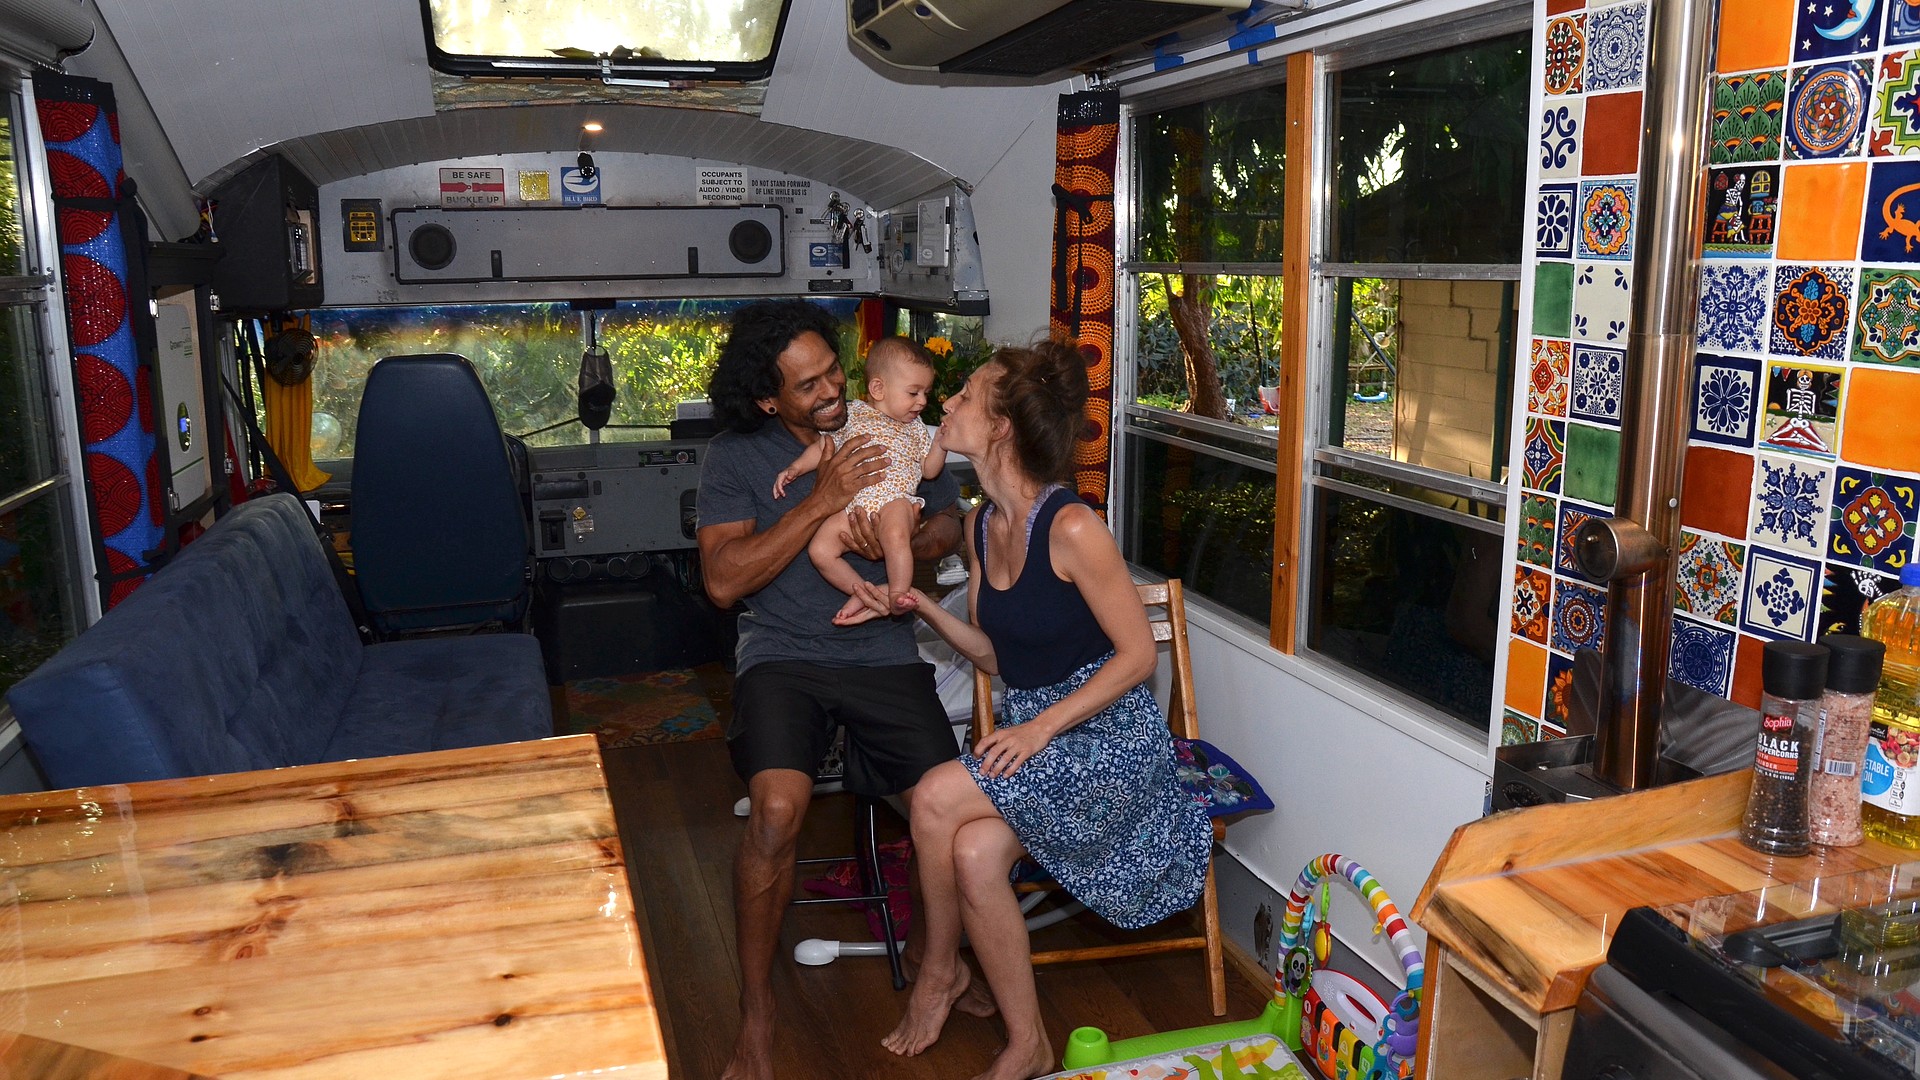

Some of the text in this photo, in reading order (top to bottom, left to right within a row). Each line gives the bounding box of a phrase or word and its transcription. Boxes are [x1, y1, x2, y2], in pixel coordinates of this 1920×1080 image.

[452, 171, 491, 179] BE SAFE
[770, 180, 786, 188] STAND
[786, 180, 811, 188] FORWARD
[775, 188, 790, 196] WHILE
[446, 196, 500, 204] BUCKLE UP
[1763, 715, 1793, 731] Sophia
[1757, 732, 1800, 752] BLACK
[1757, 743, 1799, 759] PEPPERCORNS
[1865, 759, 1890, 777] ETABLE
[1863, 770, 1874, 784] OIL
